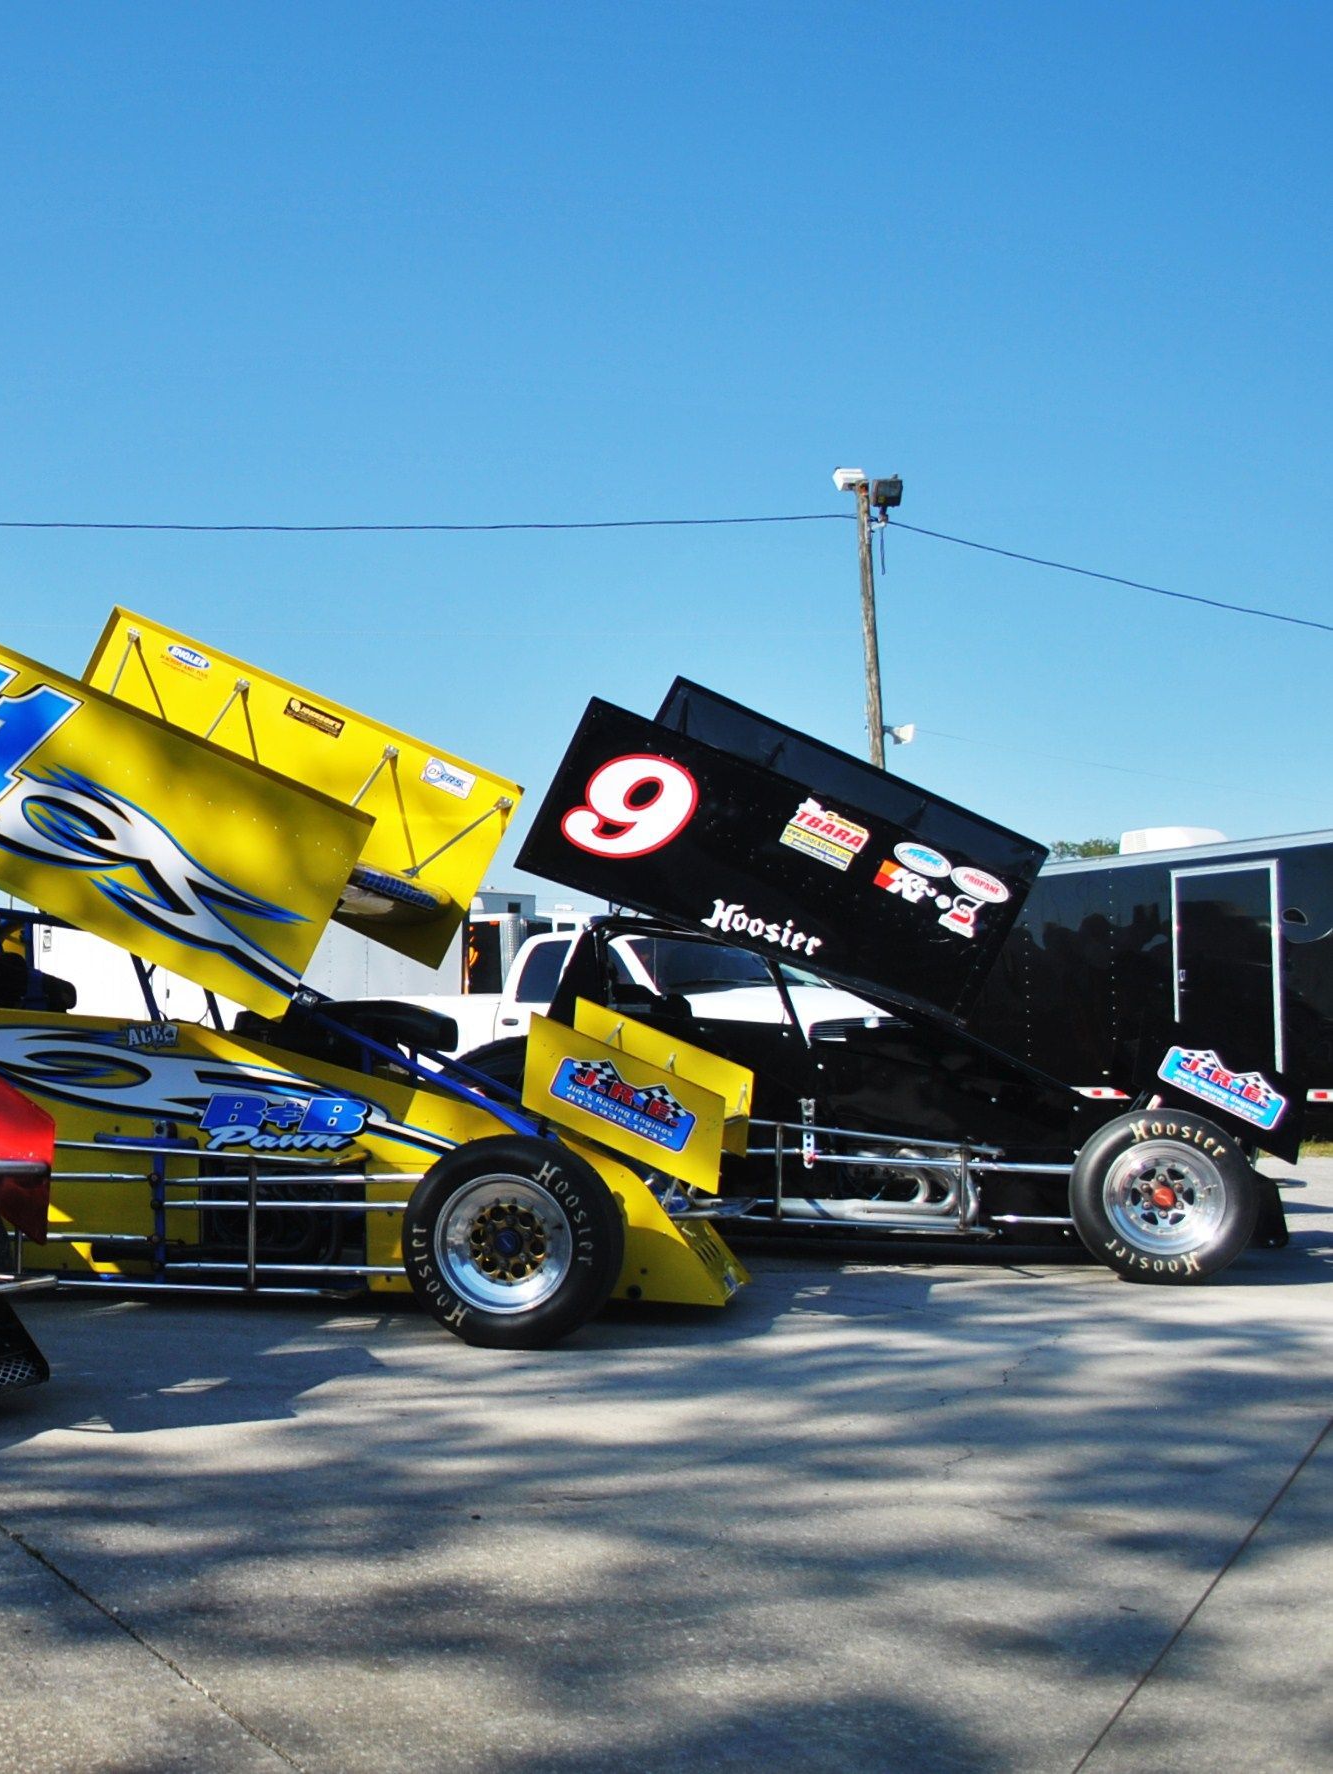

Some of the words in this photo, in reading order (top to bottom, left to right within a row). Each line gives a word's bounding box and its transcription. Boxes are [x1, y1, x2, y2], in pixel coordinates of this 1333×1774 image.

[561, 752, 699, 859] 9
[796, 811, 863, 847] TBARA
[963, 873, 1001, 895] PROPANE
[702, 899, 823, 956] Hoosier
[201, 1093, 368, 1134] B&B
[566, 1085, 593, 1100] Jim's
[595, 1095, 631, 1119] Racing
[634, 1114, 673, 1137] Engines
[207, 1125, 353, 1150] Pawn
[1129, 1119, 1226, 1158] Hoosier
[532, 1161, 594, 1267] Hoosier
[412, 1225, 473, 1328] Hoosier
[1105, 1239, 1202, 1276] Hoosier
